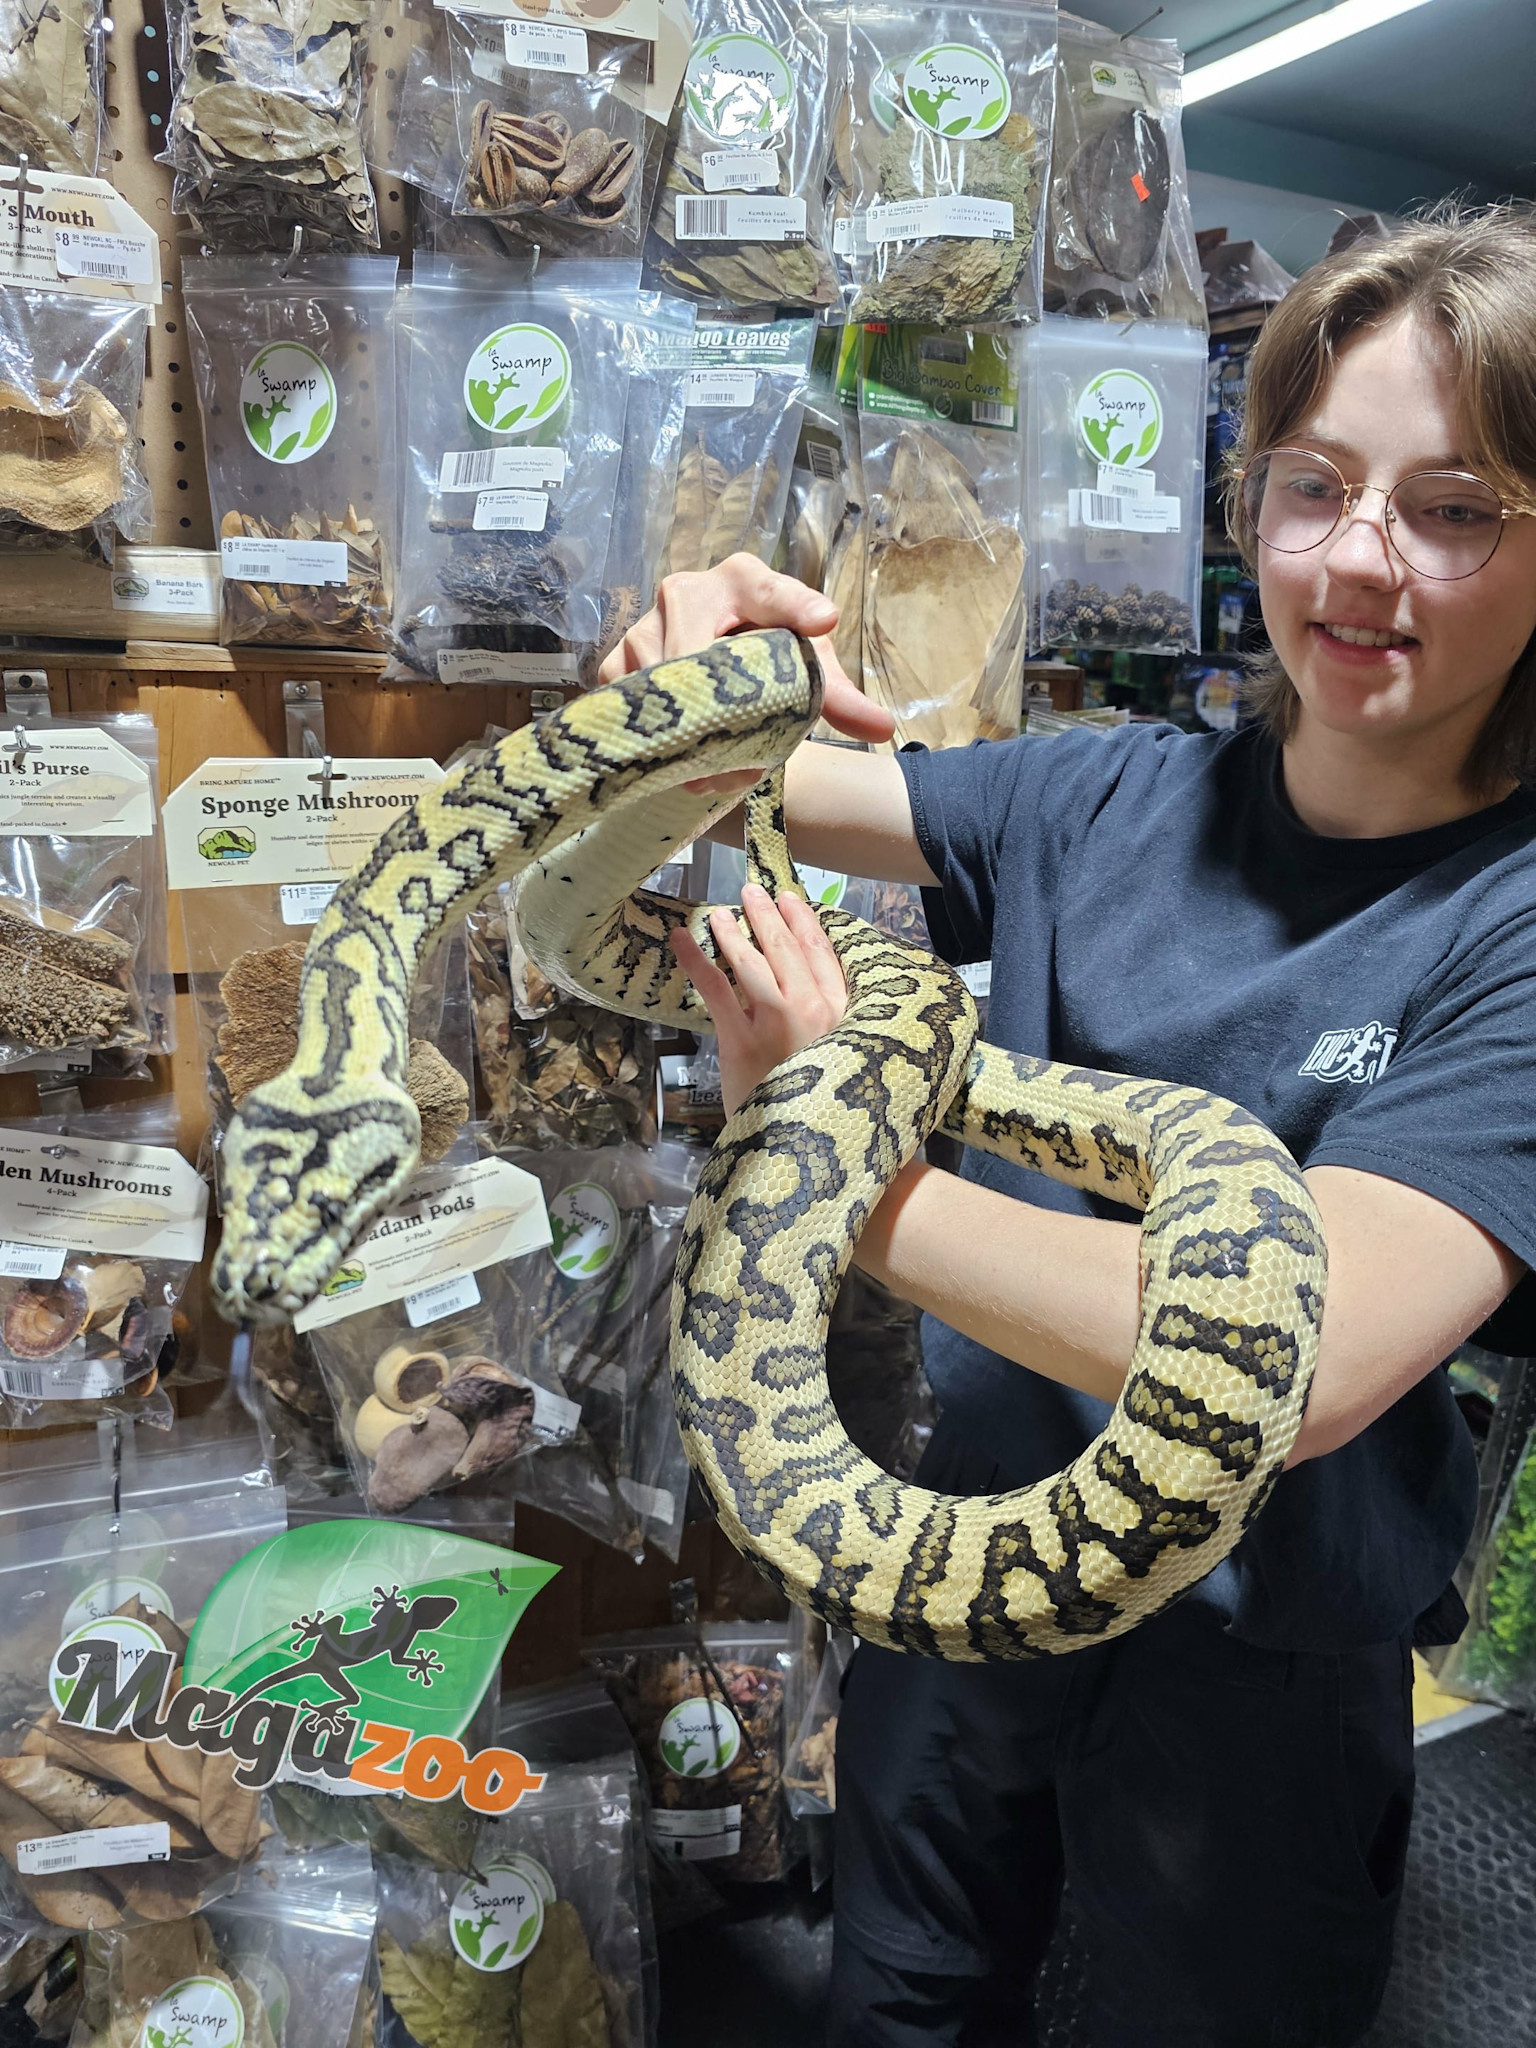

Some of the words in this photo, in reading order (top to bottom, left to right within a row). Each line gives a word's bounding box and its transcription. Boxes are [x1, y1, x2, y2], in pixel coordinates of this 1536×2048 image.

[505, 23, 517, 36] $8
[708, 53, 718, 63] la
[924, 61, 934, 72] la
[929, 70, 990, 95] Swamp
[704, 155, 716, 167] $6
[51, 186, 115, 201] WWW.NEWCALPET.COM
[25, 203, 96, 228] Mouth
[8, 222, 42, 235] 3-Pack
[836, 221, 846, 232] $5
[55, 232, 70, 246] $8
[26, 244, 45, 253] shells
[15, 250, 52, 261] decorations
[41, 275, 63, 284] Canada
[658, 330, 722, 348] Mango
[727, 330, 791, 347] Leaves
[488, 348, 497, 357] la
[491, 356, 552, 376] Swamp
[257, 368, 266, 378] la
[883, 359, 905, 386] Big
[910, 366, 961, 390] Bamboo
[965, 375, 1001, 396] Cover
[262, 377, 317, 400] Swamp
[1098, 397, 1146, 419] Swamp
[478, 496, 488, 507] $7
[223, 542, 233, 553] $8
[155, 579, 184, 588] Banana
[186, 581, 204, 589] Bark
[168, 588, 194, 597] 3-Pack
[32, 761, 90, 775] Purse
[9, 779, 41, 787] 2-Pack
[351, 774, 425, 782] WWW.NEWCALPET.COM
[93, 794, 116, 802] visually
[201, 795, 290, 819] Sponge
[306, 814, 338, 823] 2-Pack
[309, 833, 324, 841] decay
[236, 859, 251, 867] PET
[281, 887, 300, 899] $11
[97, 1158, 171, 1172] WWW.NEWCALPET.COM
[38, 1166, 172, 1197] Mushrooms
[47, 1188, 77, 1198] 4-Pack
[429, 1195, 476, 1221] Pods
[569, 1202, 610, 1237] Swamp
[404, 1227, 433, 1243] 2-Pack
[406, 1294, 417, 1306] $9
[677, 1721, 723, 1735] Swamp
[17, 1843, 36, 1854] $13
[473, 1895, 525, 1914] Swamp
[171, 2006, 227, 2038] Swamp
